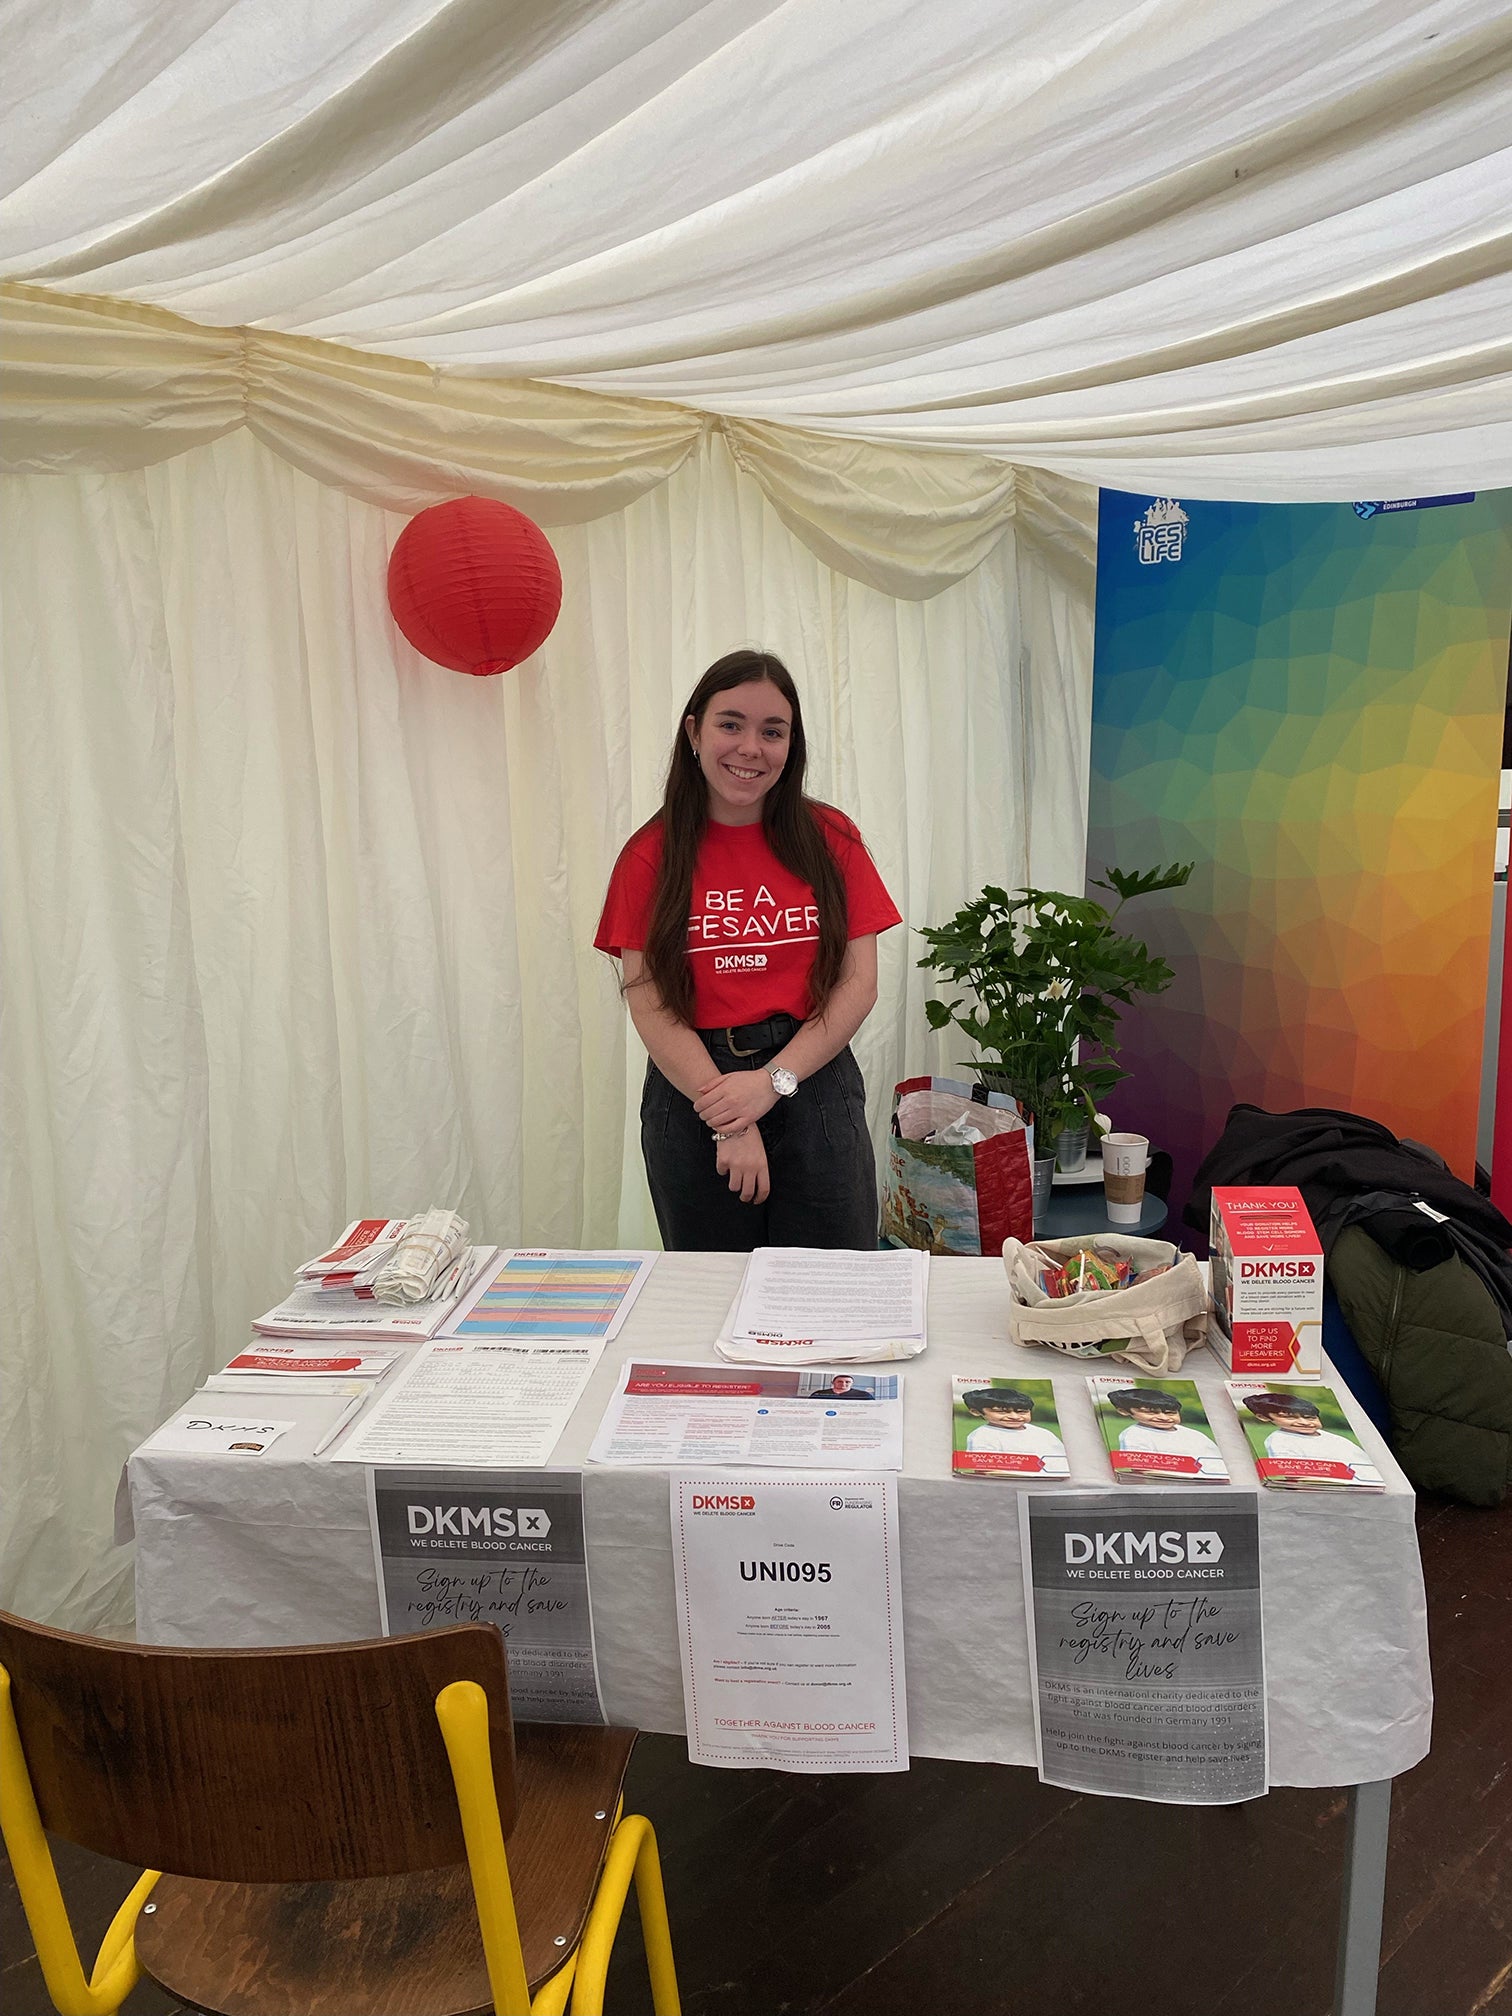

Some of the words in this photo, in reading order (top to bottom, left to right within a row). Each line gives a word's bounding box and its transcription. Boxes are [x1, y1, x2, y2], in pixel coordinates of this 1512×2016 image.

[1382, 500, 1417, 510] EDINBURGH
[1141, 526, 1181, 547] RES
[1140, 543, 1180, 562] LIFE
[705, 889, 744, 911] BE
[753, 885, 776, 908] A
[686, 905, 820, 939] FESAVER
[1225, 1201, 1267, 1211] THANK
[1268, 1201, 1299, 1210] YOU!
[407, 1505, 516, 1538] DKMS
[410, 1539, 428, 1548] WE
[430, 1540, 468, 1549] DELETE
[470, 1541, 507, 1550] BLOOD
[509, 1542, 553, 1552] CANCER
[1064, 1531, 1185, 1565] DKMS
[739, 1561, 832, 1583] UNI095
[1066, 1569, 1086, 1579] WE
[1088, 1570, 1131, 1580] DELETE
[1133, 1569, 1174, 1580] BLOOD
[1176, 1569, 1225, 1579] CANCER
[416, 1567, 466, 1602] Sign
[470, 1573, 491, 1594] up
[516, 1567, 553, 1595] the
[407, 1592, 485, 1626] registry
[488, 1592, 524, 1616] and
[526, 1598, 570, 1614] save
[1070, 1601, 1127, 1639] Sign
[1132, 1606, 1156, 1630] up
[1181, 1596, 1223, 1629] the
[521, 1648, 562, 1657] dedicated
[1059, 1629, 1146, 1665] registry
[1150, 1625, 1192, 1653] and
[1193, 1631, 1241, 1651] save
[1125, 1658, 1180, 1681] lives
[1044, 1680, 1072, 1693] DKMS
[1082, 1687, 1095, 1695] an
[1151, 1690, 1184, 1702] charity
[1185, 1691, 1231, 1700] dedicated
[1232, 1690, 1242, 1699] to
[1243, 1689, 1260, 1698] the
[1047, 1692, 1068, 1704] fight
[1070, 1696, 1103, 1707] against
[1104, 1699, 1131, 1710] blood
[1132, 1703, 1163, 1712] cancer
[1165, 1704, 1184, 1713] and
[1185, 1704, 1213, 1712] blood
[1214, 1703, 1257, 1712] disorders
[714, 1718, 761, 1728] TOGETHER
[763, 1721, 801, 1730] AGAINST
[803, 1723, 835, 1731] BLOOD
[837, 1722, 876, 1730] CANCER
[1073, 1709, 1092, 1718] that
[1113, 1712, 1153, 1724] founded
[1165, 1716, 1208, 1727] Germany
[1210, 1716, 1232, 1725] 1991
[1045, 1727, 1067, 1738] Help
[1068, 1731, 1085, 1741] join
[1087, 1734, 1102, 1743] the
[1104, 1735, 1125, 1747] fight
[1126, 1739, 1160, 1750] against
[1162, 1741, 1189, 1751] blood
[1191, 1741, 1221, 1751] cancer
[1223, 1742, 1235, 1752] by
[1056, 1741, 1068, 1750] up
[1070, 1743, 1080, 1752] to
[1081, 1745, 1097, 1754] the
[1098, 1747, 1126, 1758] DKMS
[1128, 1751, 1164, 1762] register
[1165, 1754, 1184, 1763] and
[1185, 1754, 1207, 1764] help
